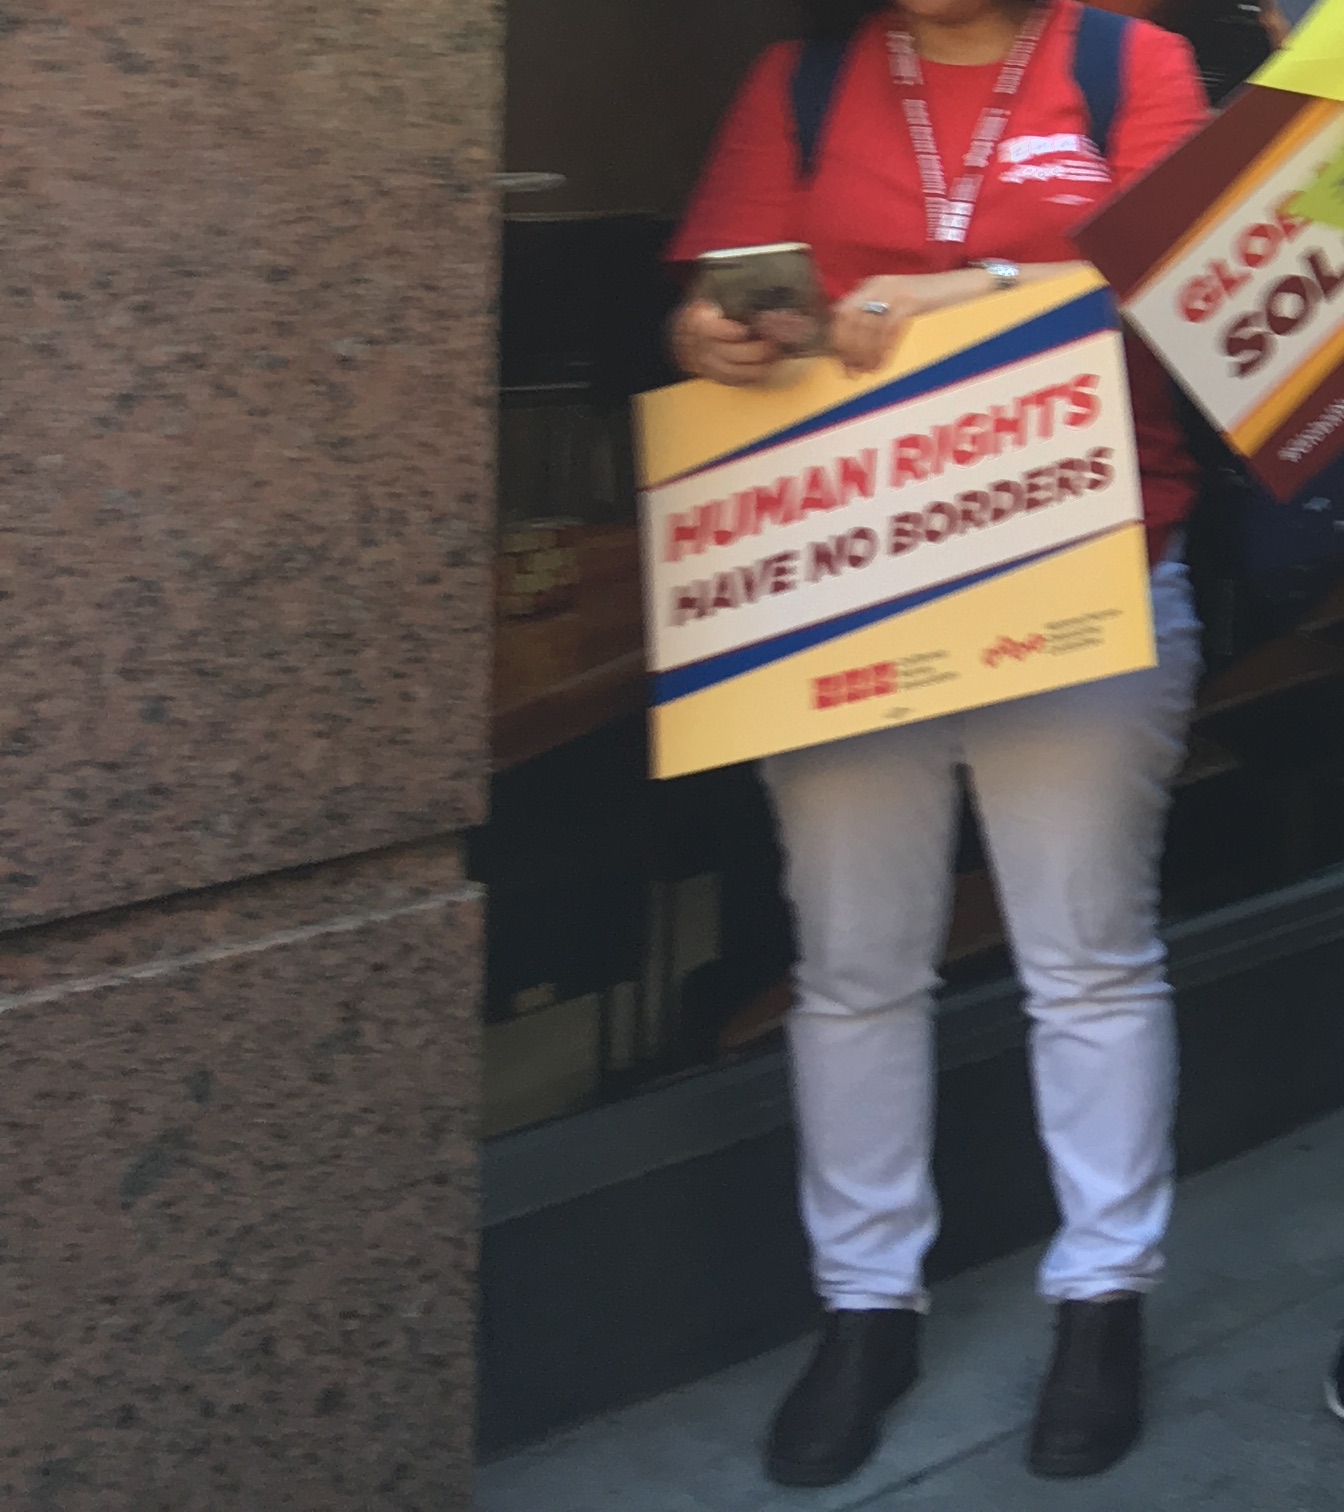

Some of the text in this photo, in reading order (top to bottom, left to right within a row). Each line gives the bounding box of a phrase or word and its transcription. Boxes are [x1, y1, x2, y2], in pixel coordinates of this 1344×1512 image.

[664, 373, 1102, 563] HUMAN RIGHTS
[669, 446, 1116, 627] HAVE NO BORDERS
